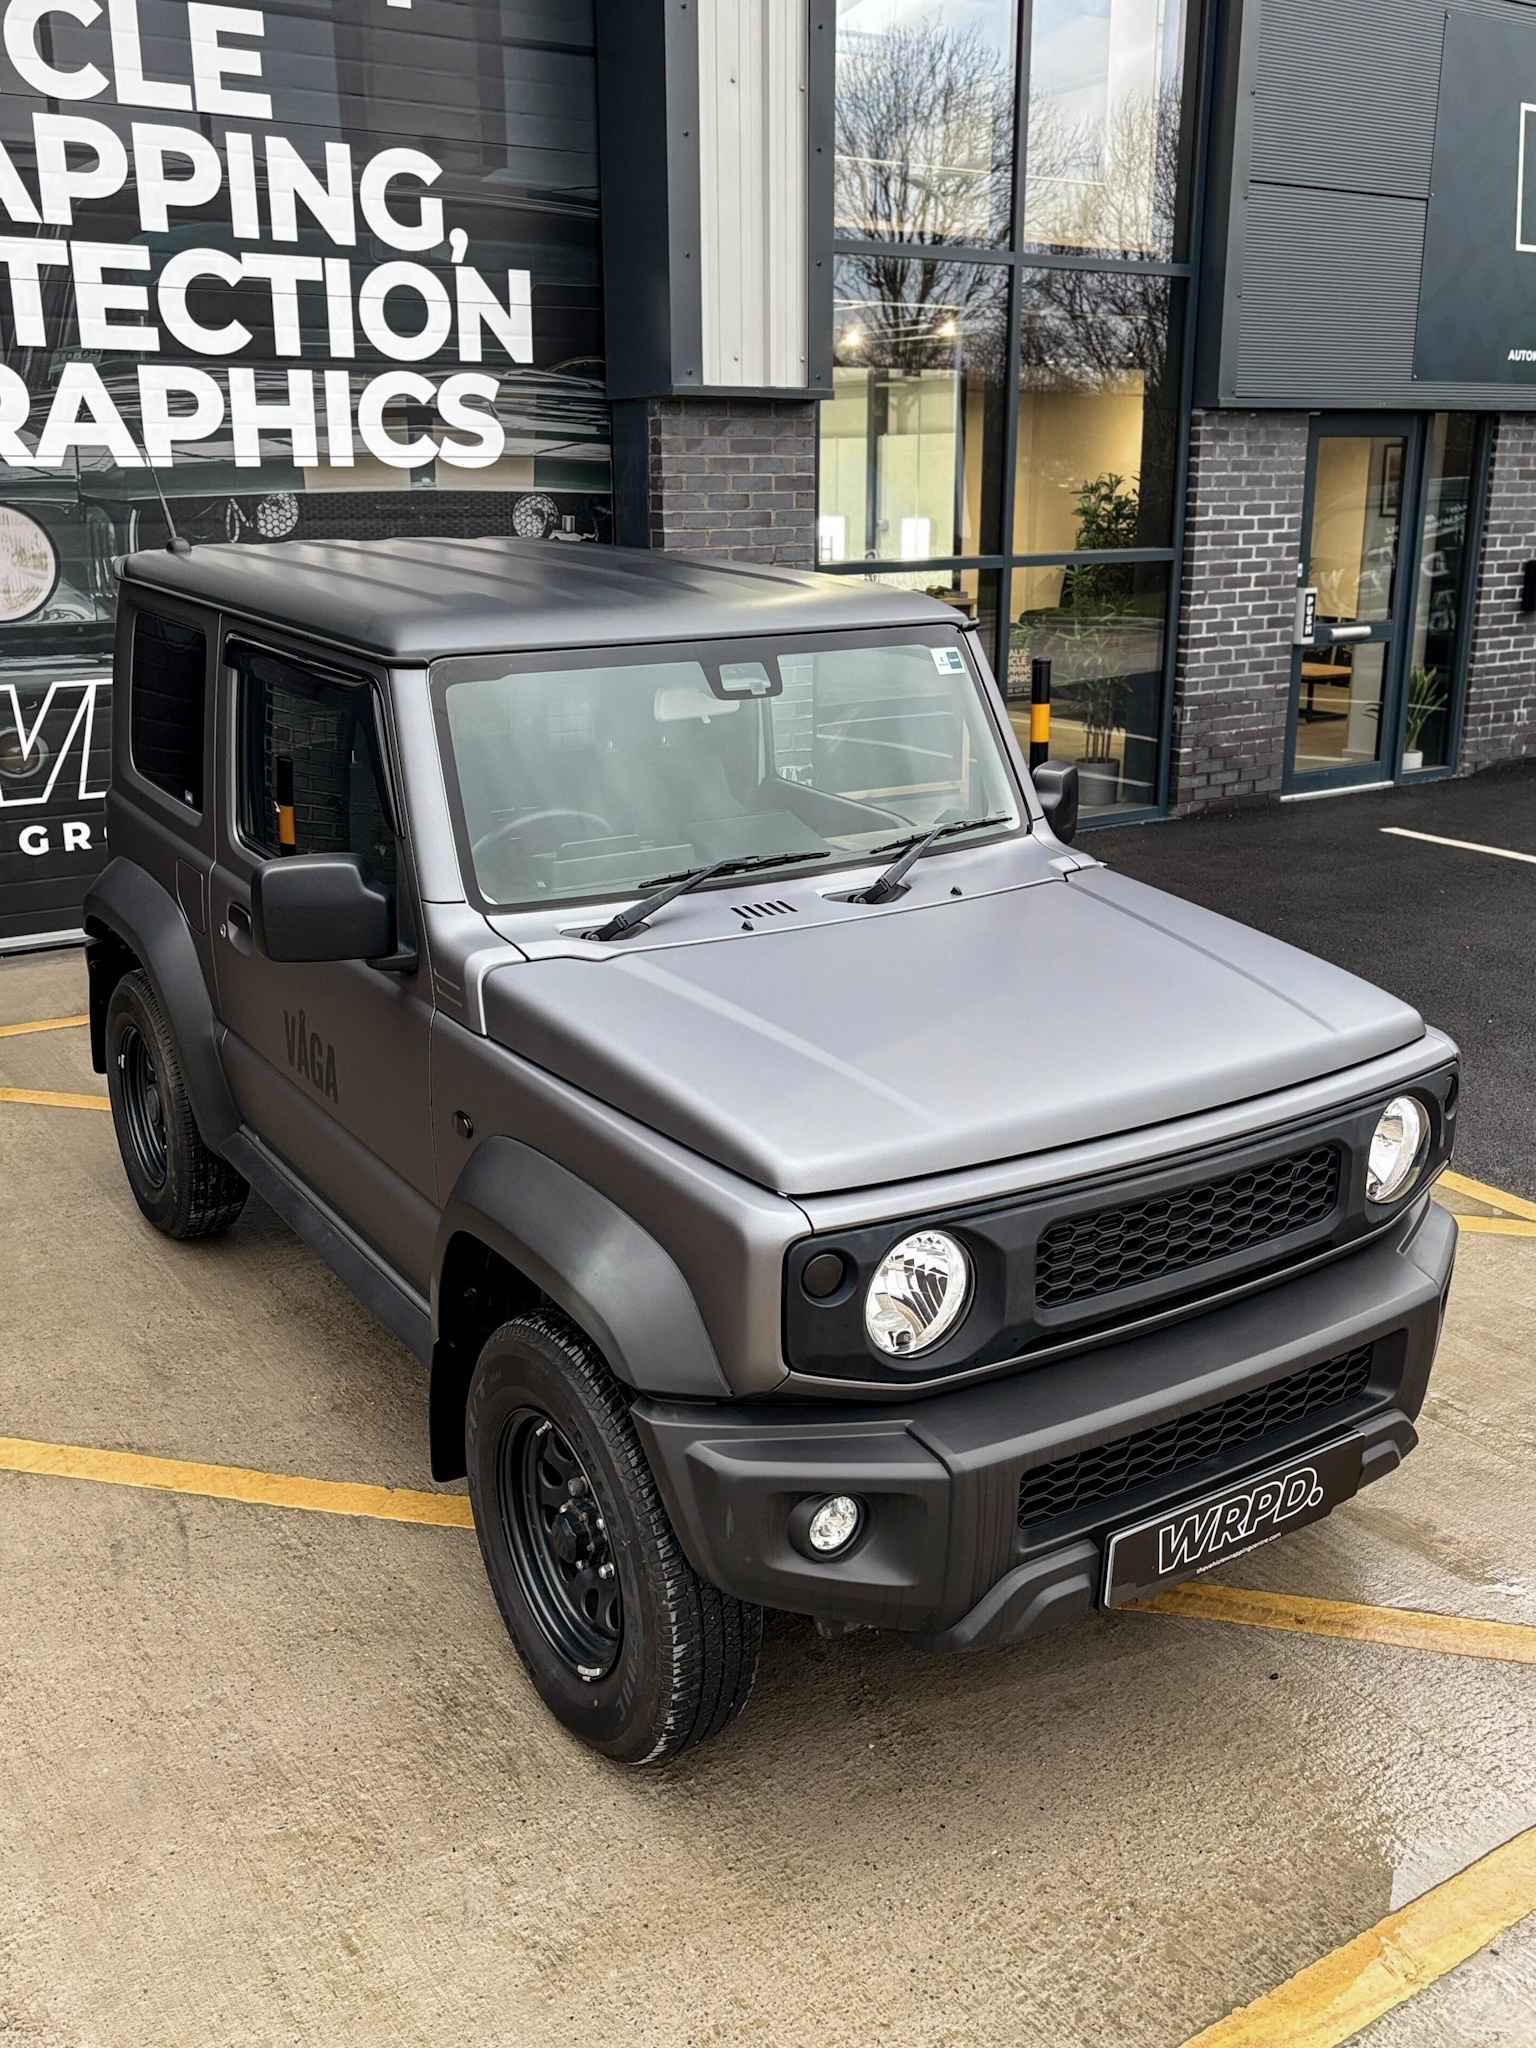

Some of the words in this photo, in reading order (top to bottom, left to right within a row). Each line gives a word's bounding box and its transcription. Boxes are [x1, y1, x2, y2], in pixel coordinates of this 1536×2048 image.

[4, 0, 273, 119] CLE
[0, 236, 533, 363] TECTION
[1508, 349, 1536, 361] AUTO
[1304, 595, 1315, 635] PUSH
[18, 821, 108, 857] GR
[283, 1008, 339, 1106] VÅGA
[1158, 1466, 1324, 1575] WRPD.
